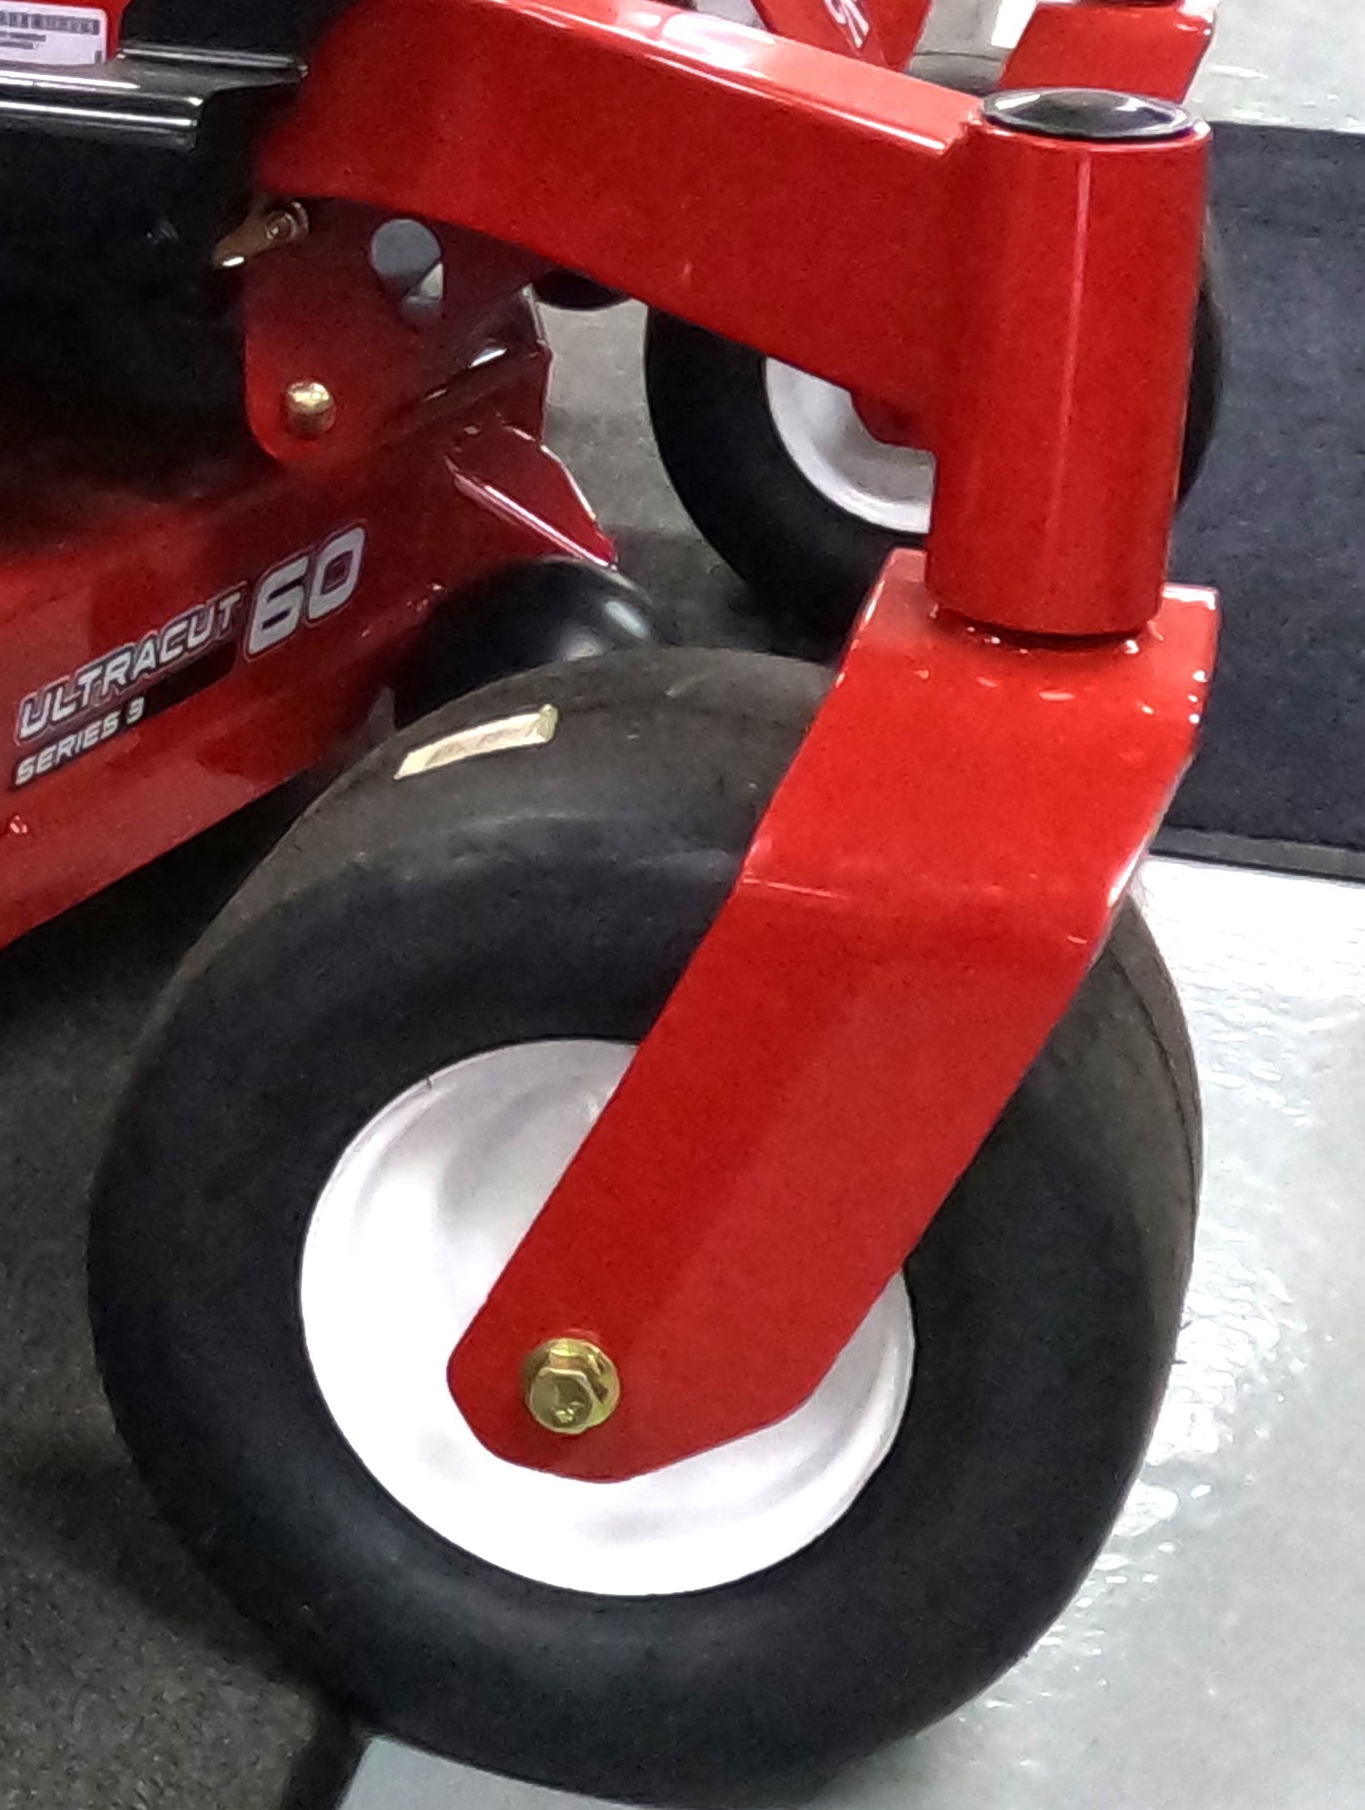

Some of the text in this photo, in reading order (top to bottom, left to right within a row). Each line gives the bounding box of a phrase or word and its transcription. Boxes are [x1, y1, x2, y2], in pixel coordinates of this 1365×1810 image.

[19, 525, 366, 741] ULTRACUT 60
[14, 709, 120, 786] SERIES
